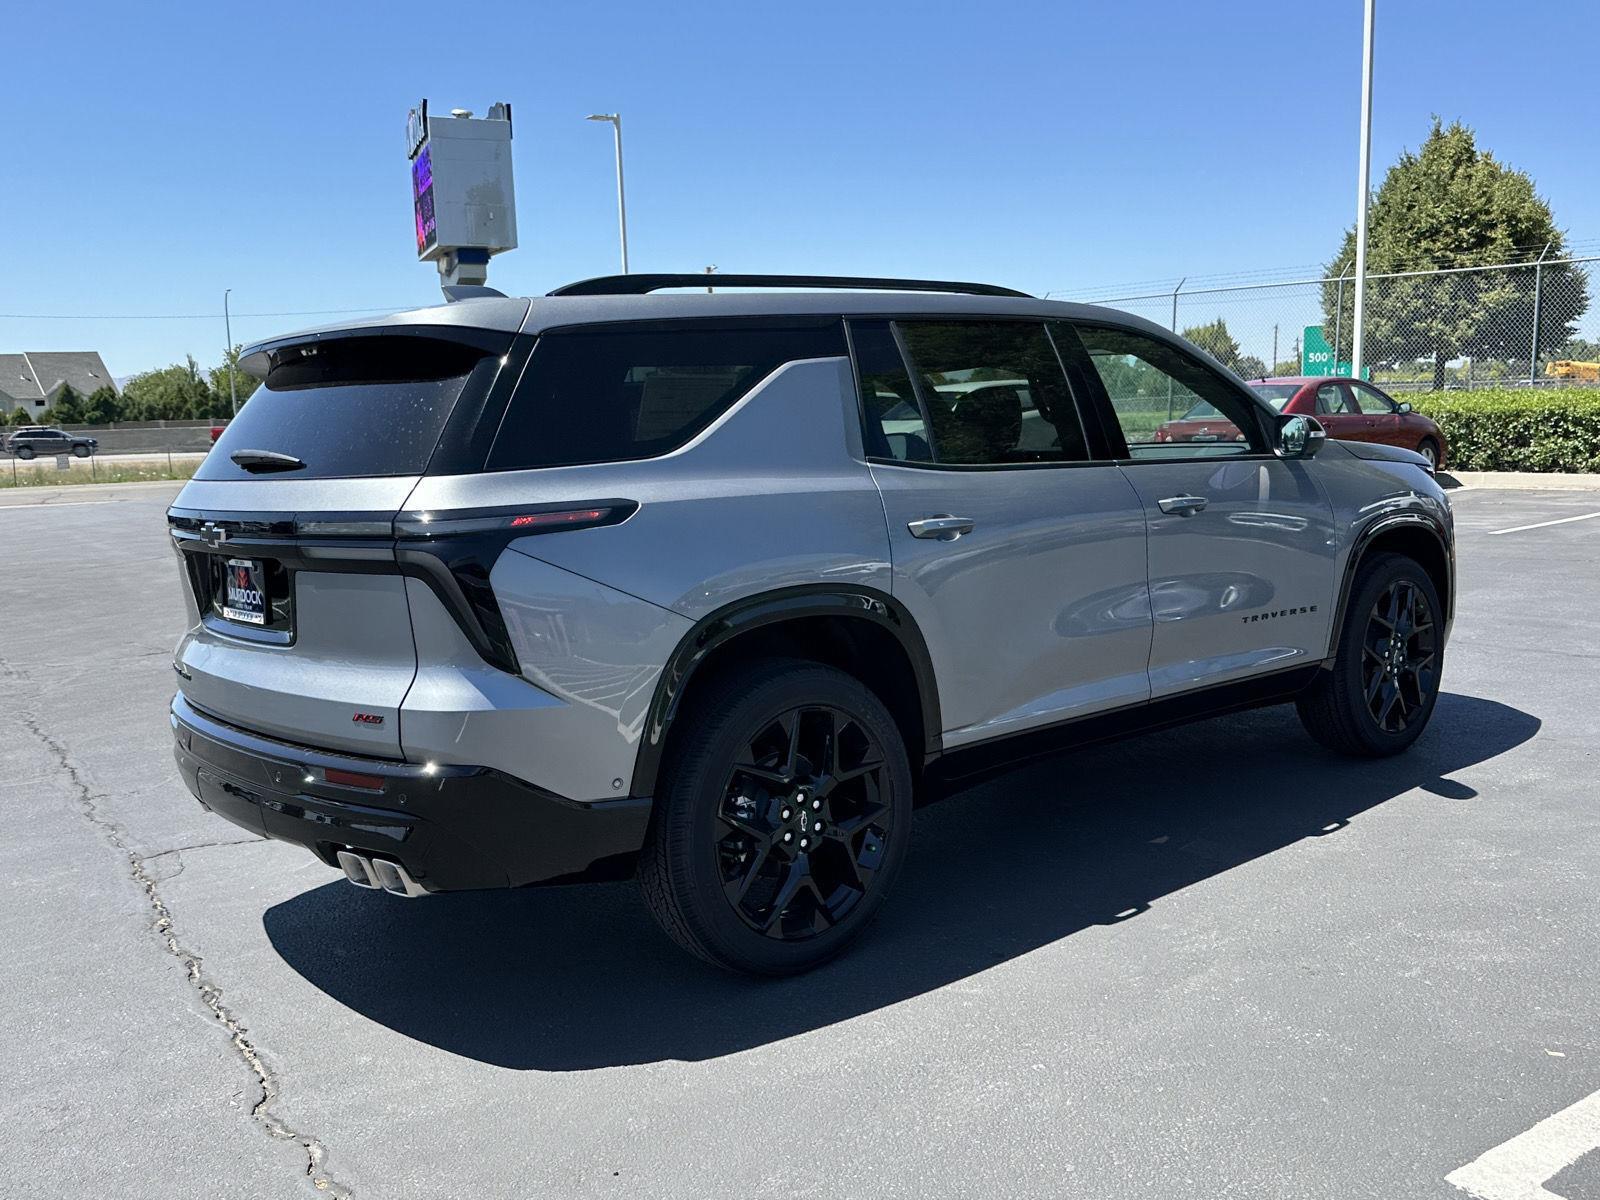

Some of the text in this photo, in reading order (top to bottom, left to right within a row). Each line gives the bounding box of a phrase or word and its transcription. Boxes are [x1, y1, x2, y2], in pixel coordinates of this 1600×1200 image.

[1308, 352, 1328, 363] 500
[1330, 367, 1346, 375] MLE
[227, 587, 262, 605] MURDOCK
[1241, 605, 1318, 623] TRAVERSE
